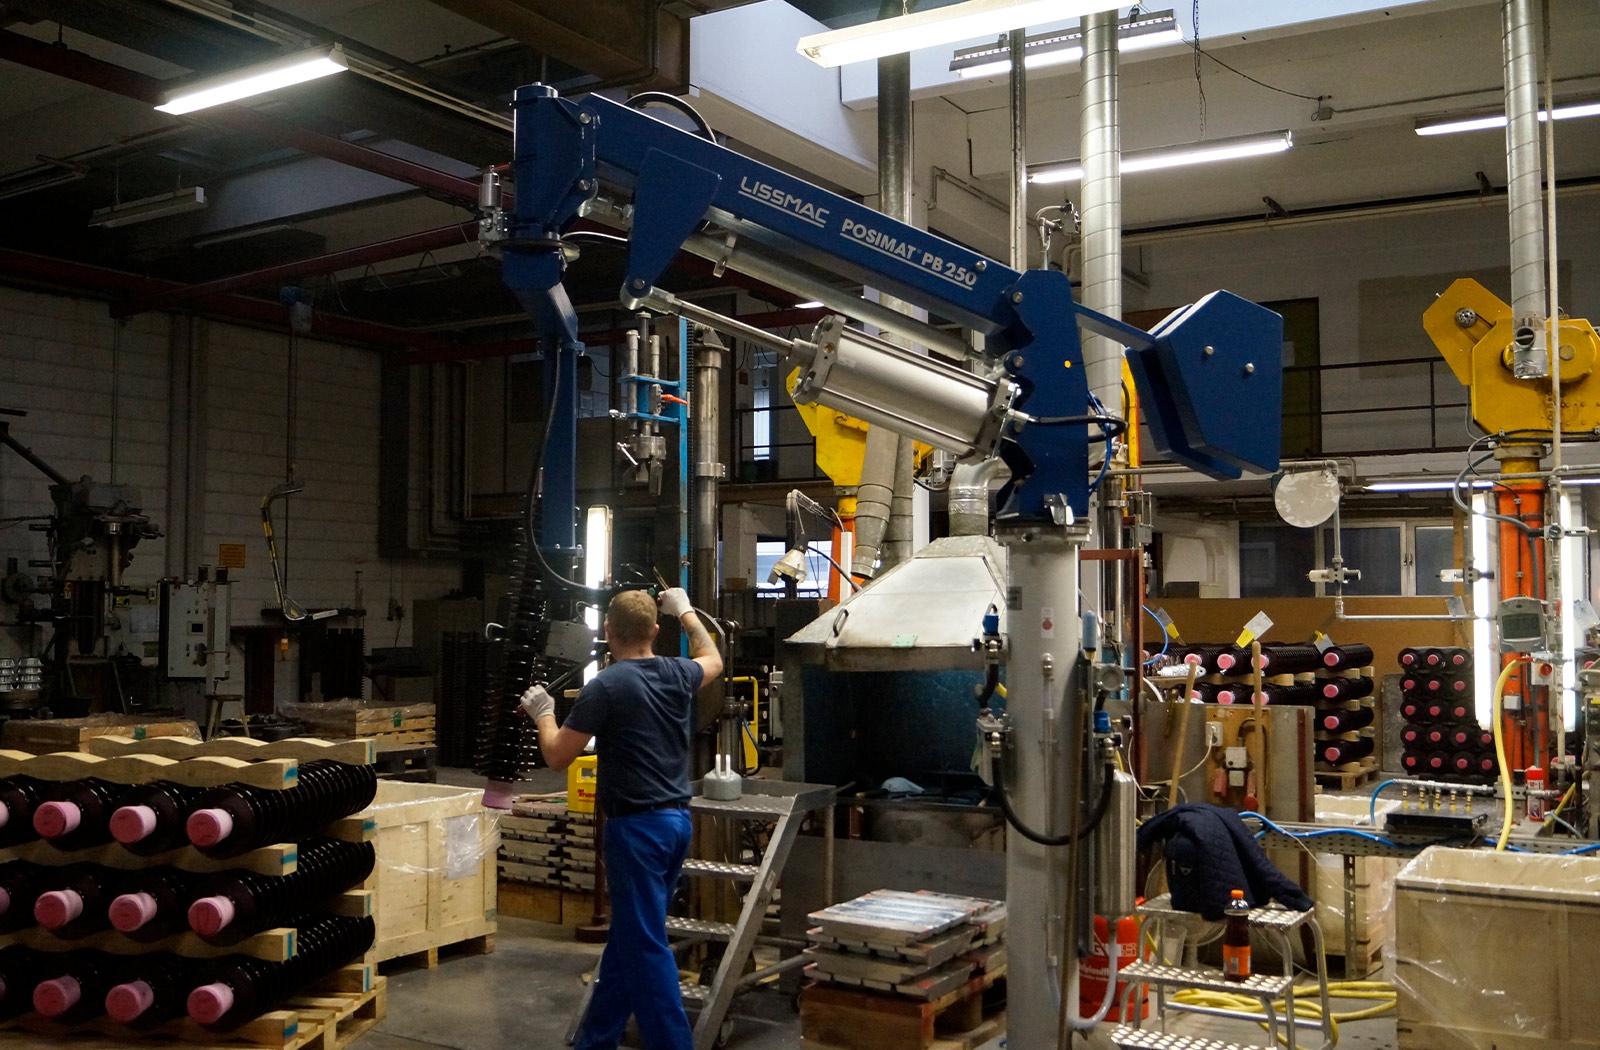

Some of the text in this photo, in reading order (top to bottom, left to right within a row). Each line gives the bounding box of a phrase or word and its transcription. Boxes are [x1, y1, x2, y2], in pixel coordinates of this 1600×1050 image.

[739, 176, 977, 286] LISSMAC POSIMAT PB 250
